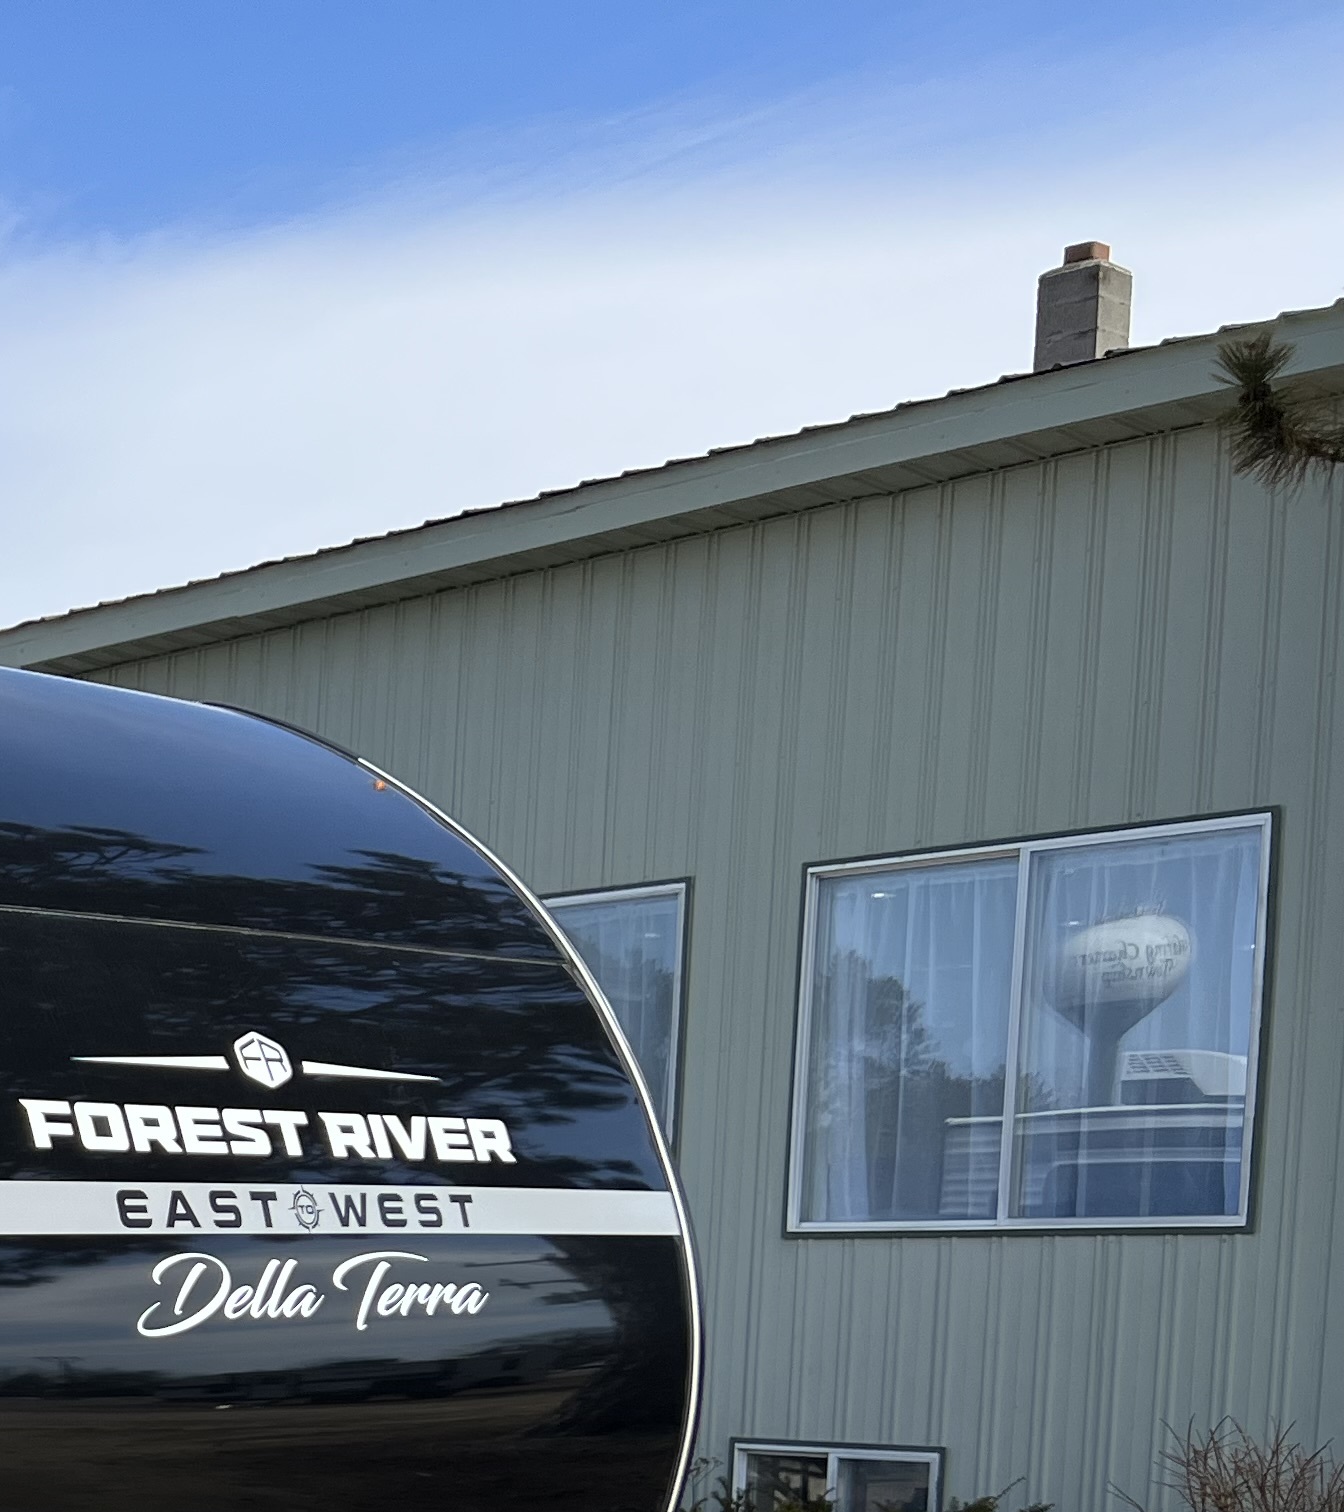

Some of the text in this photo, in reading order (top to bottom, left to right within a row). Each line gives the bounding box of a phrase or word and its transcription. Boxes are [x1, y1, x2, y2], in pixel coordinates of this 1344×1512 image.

[18, 1098, 518, 1165] FOREST RIVER
[115, 1189, 278, 1229] EAST
[327, 1192, 474, 1229] WEST
[136, 1250, 491, 1339] Della Terra
